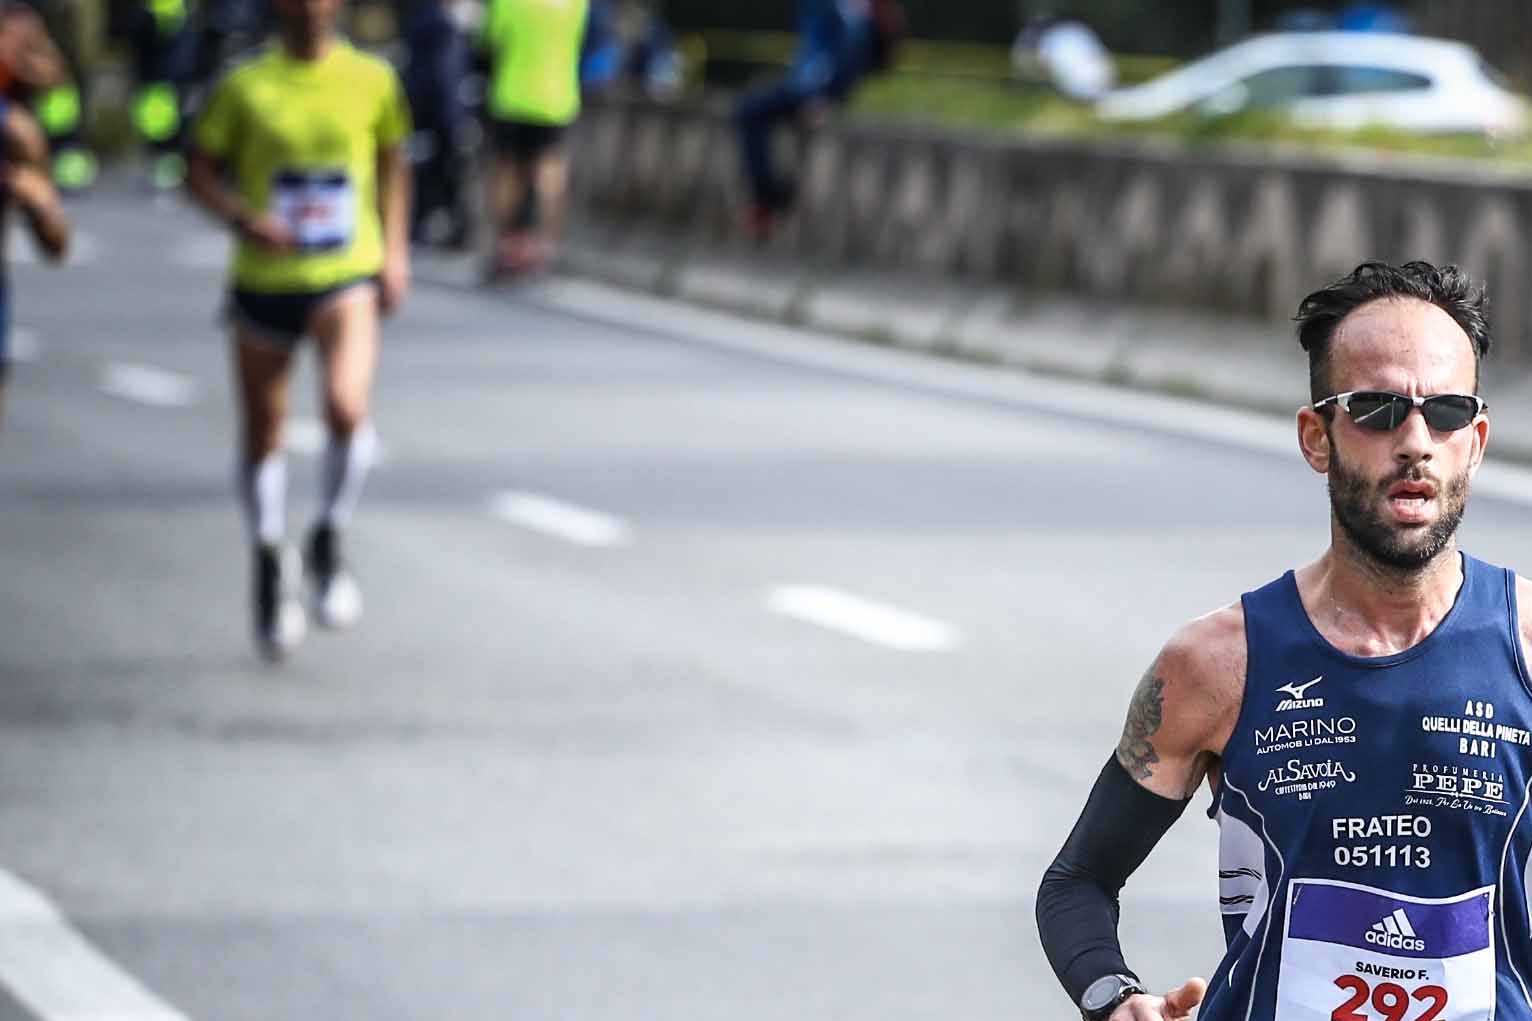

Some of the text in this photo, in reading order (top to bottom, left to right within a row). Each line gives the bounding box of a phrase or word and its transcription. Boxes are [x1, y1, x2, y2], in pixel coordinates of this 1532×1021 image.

[1254, 717, 1356, 746] MARINO
[1422, 716, 1531, 746] QUELLI DELLA PINETA
[1256, 735, 1356, 755] AUTOMOBLI DAL 1953
[1459, 737, 1496, 759] BARI
[1412, 763, 1504, 783] PROFUMERIA
[1412, 773, 1504, 800] PEPE
[1332, 815, 1432, 839] FRATEO
[1334, 845, 1431, 868] 051113
[1365, 929, 1425, 951] adidas
[1355, 961, 1430, 981] SAVERIO F.
